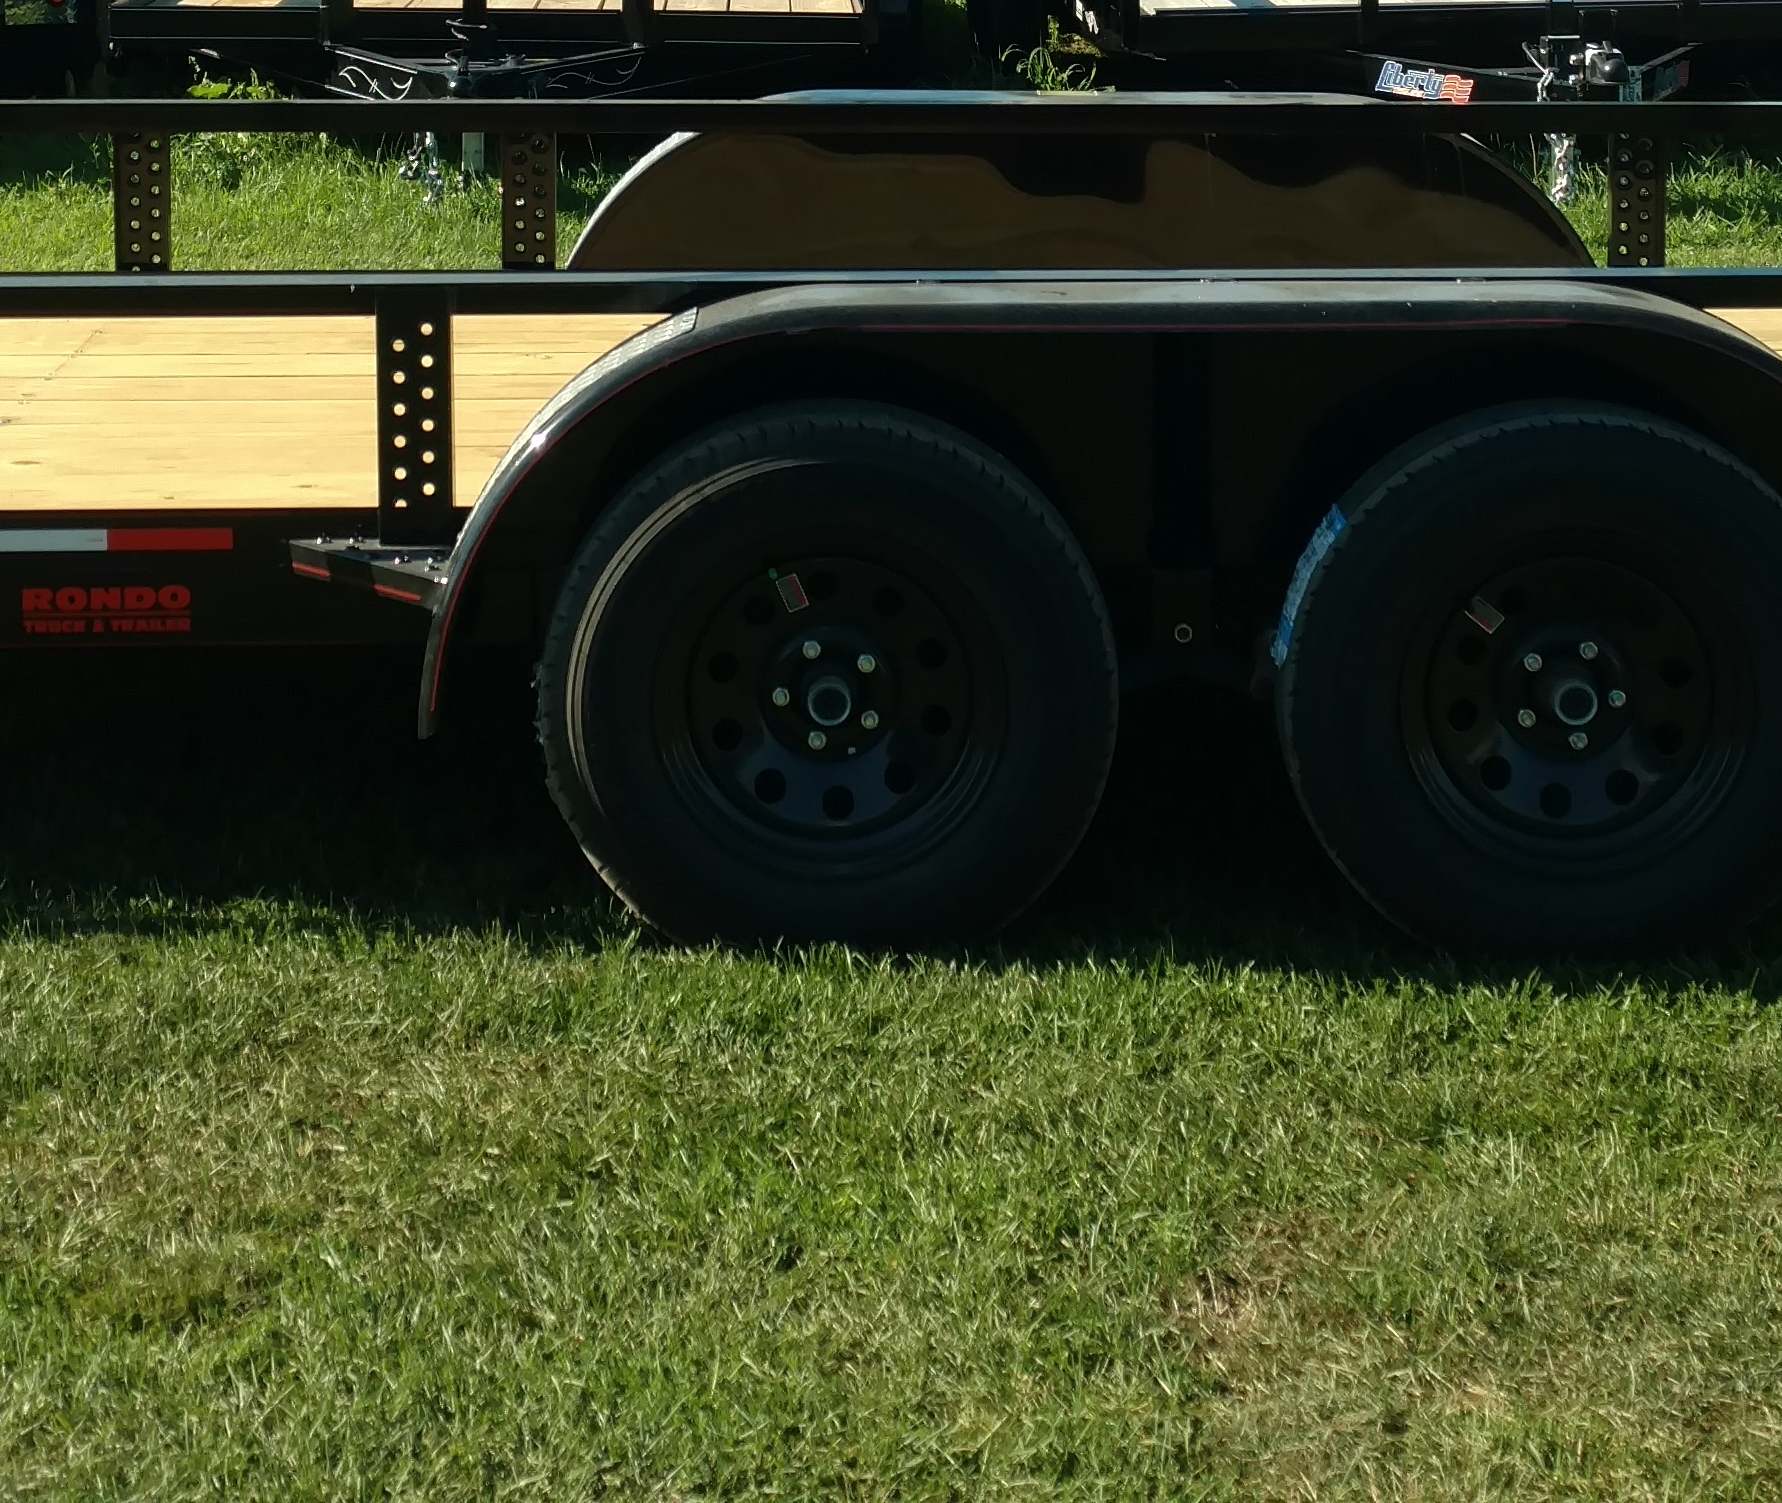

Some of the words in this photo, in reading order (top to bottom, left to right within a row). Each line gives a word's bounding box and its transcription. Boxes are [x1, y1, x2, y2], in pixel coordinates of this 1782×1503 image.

[22, 585, 191, 611] RONDO
[23, 620, 85, 633] TRUCK
[110, 618, 191, 633] TRAILER
